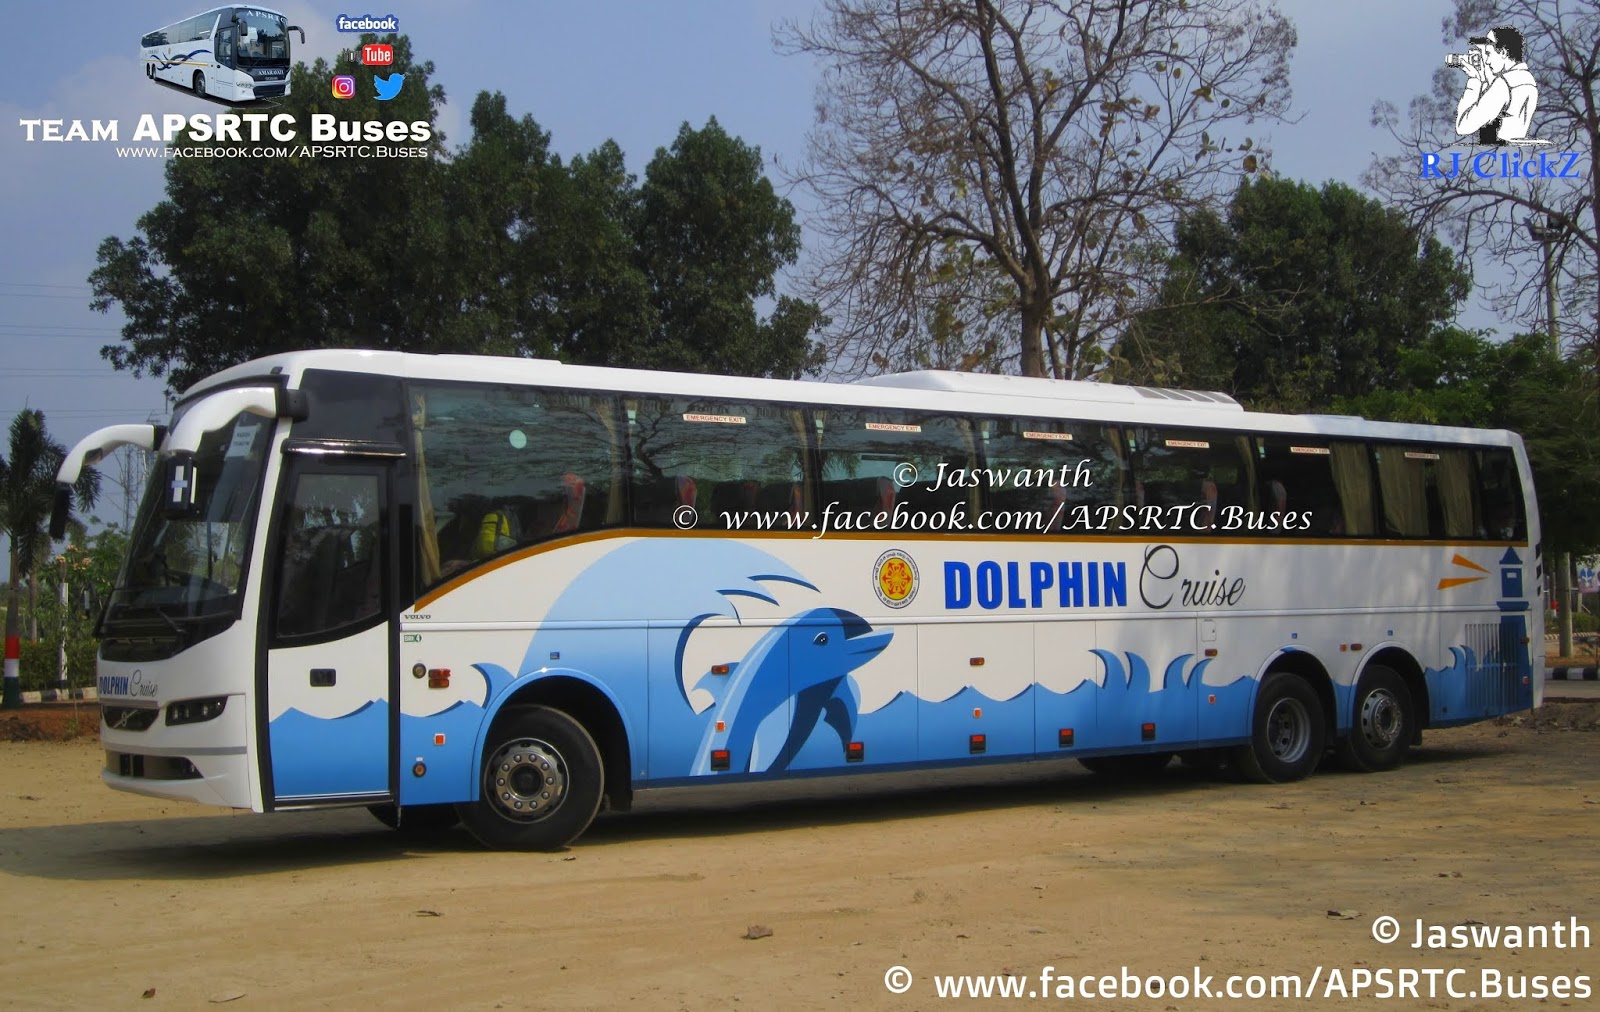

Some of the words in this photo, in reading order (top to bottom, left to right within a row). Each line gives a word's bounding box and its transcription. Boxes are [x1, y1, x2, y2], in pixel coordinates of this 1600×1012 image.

[943, 560, 1127, 609] DOLPHIN
[1139, 544, 1246, 610] Cruise
[99, 676, 128, 695] DOLPHIN
[130, 669, 158, 697] Cruise
